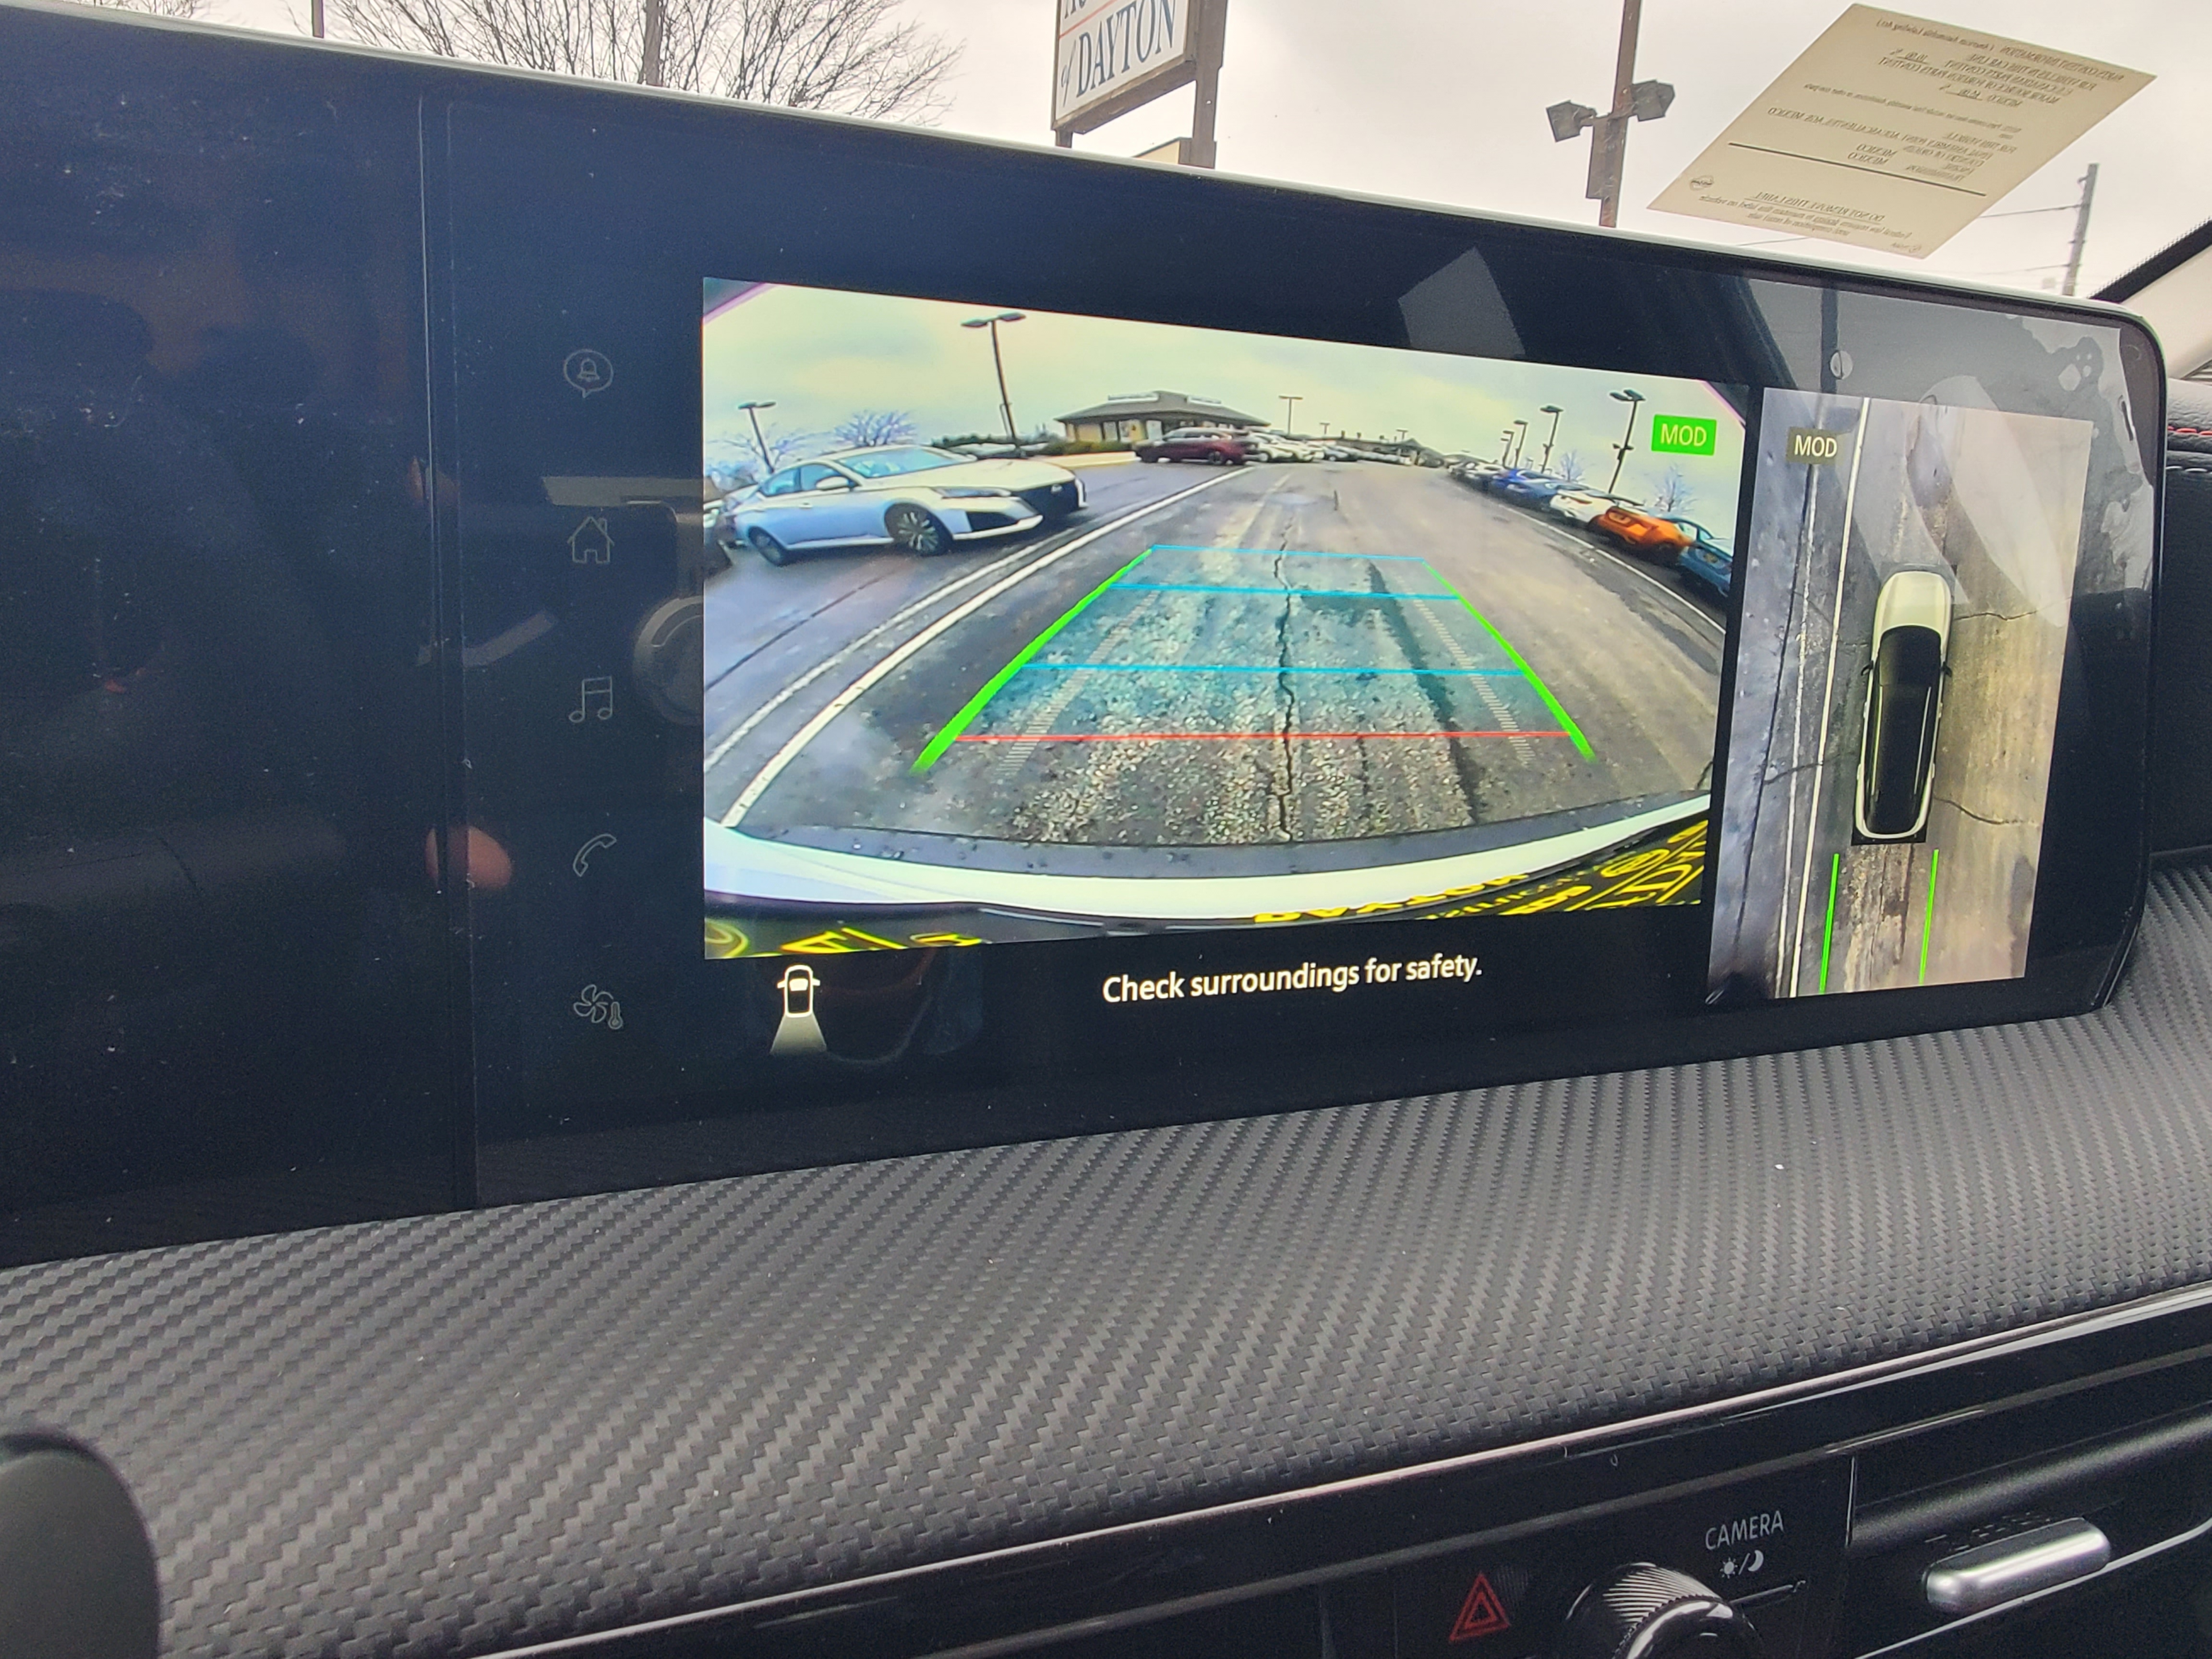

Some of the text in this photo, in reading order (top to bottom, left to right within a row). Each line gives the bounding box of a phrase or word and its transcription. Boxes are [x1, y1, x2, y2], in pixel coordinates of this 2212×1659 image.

[1076, 0, 1176, 97] DAYTON
[1660, 423, 1707, 446] MOD
[1794, 434, 1838, 457] MOD
[1102, 953, 1482, 1003] Check surroundings for safety.
[1705, 1510, 1784, 1551] CAMERA
